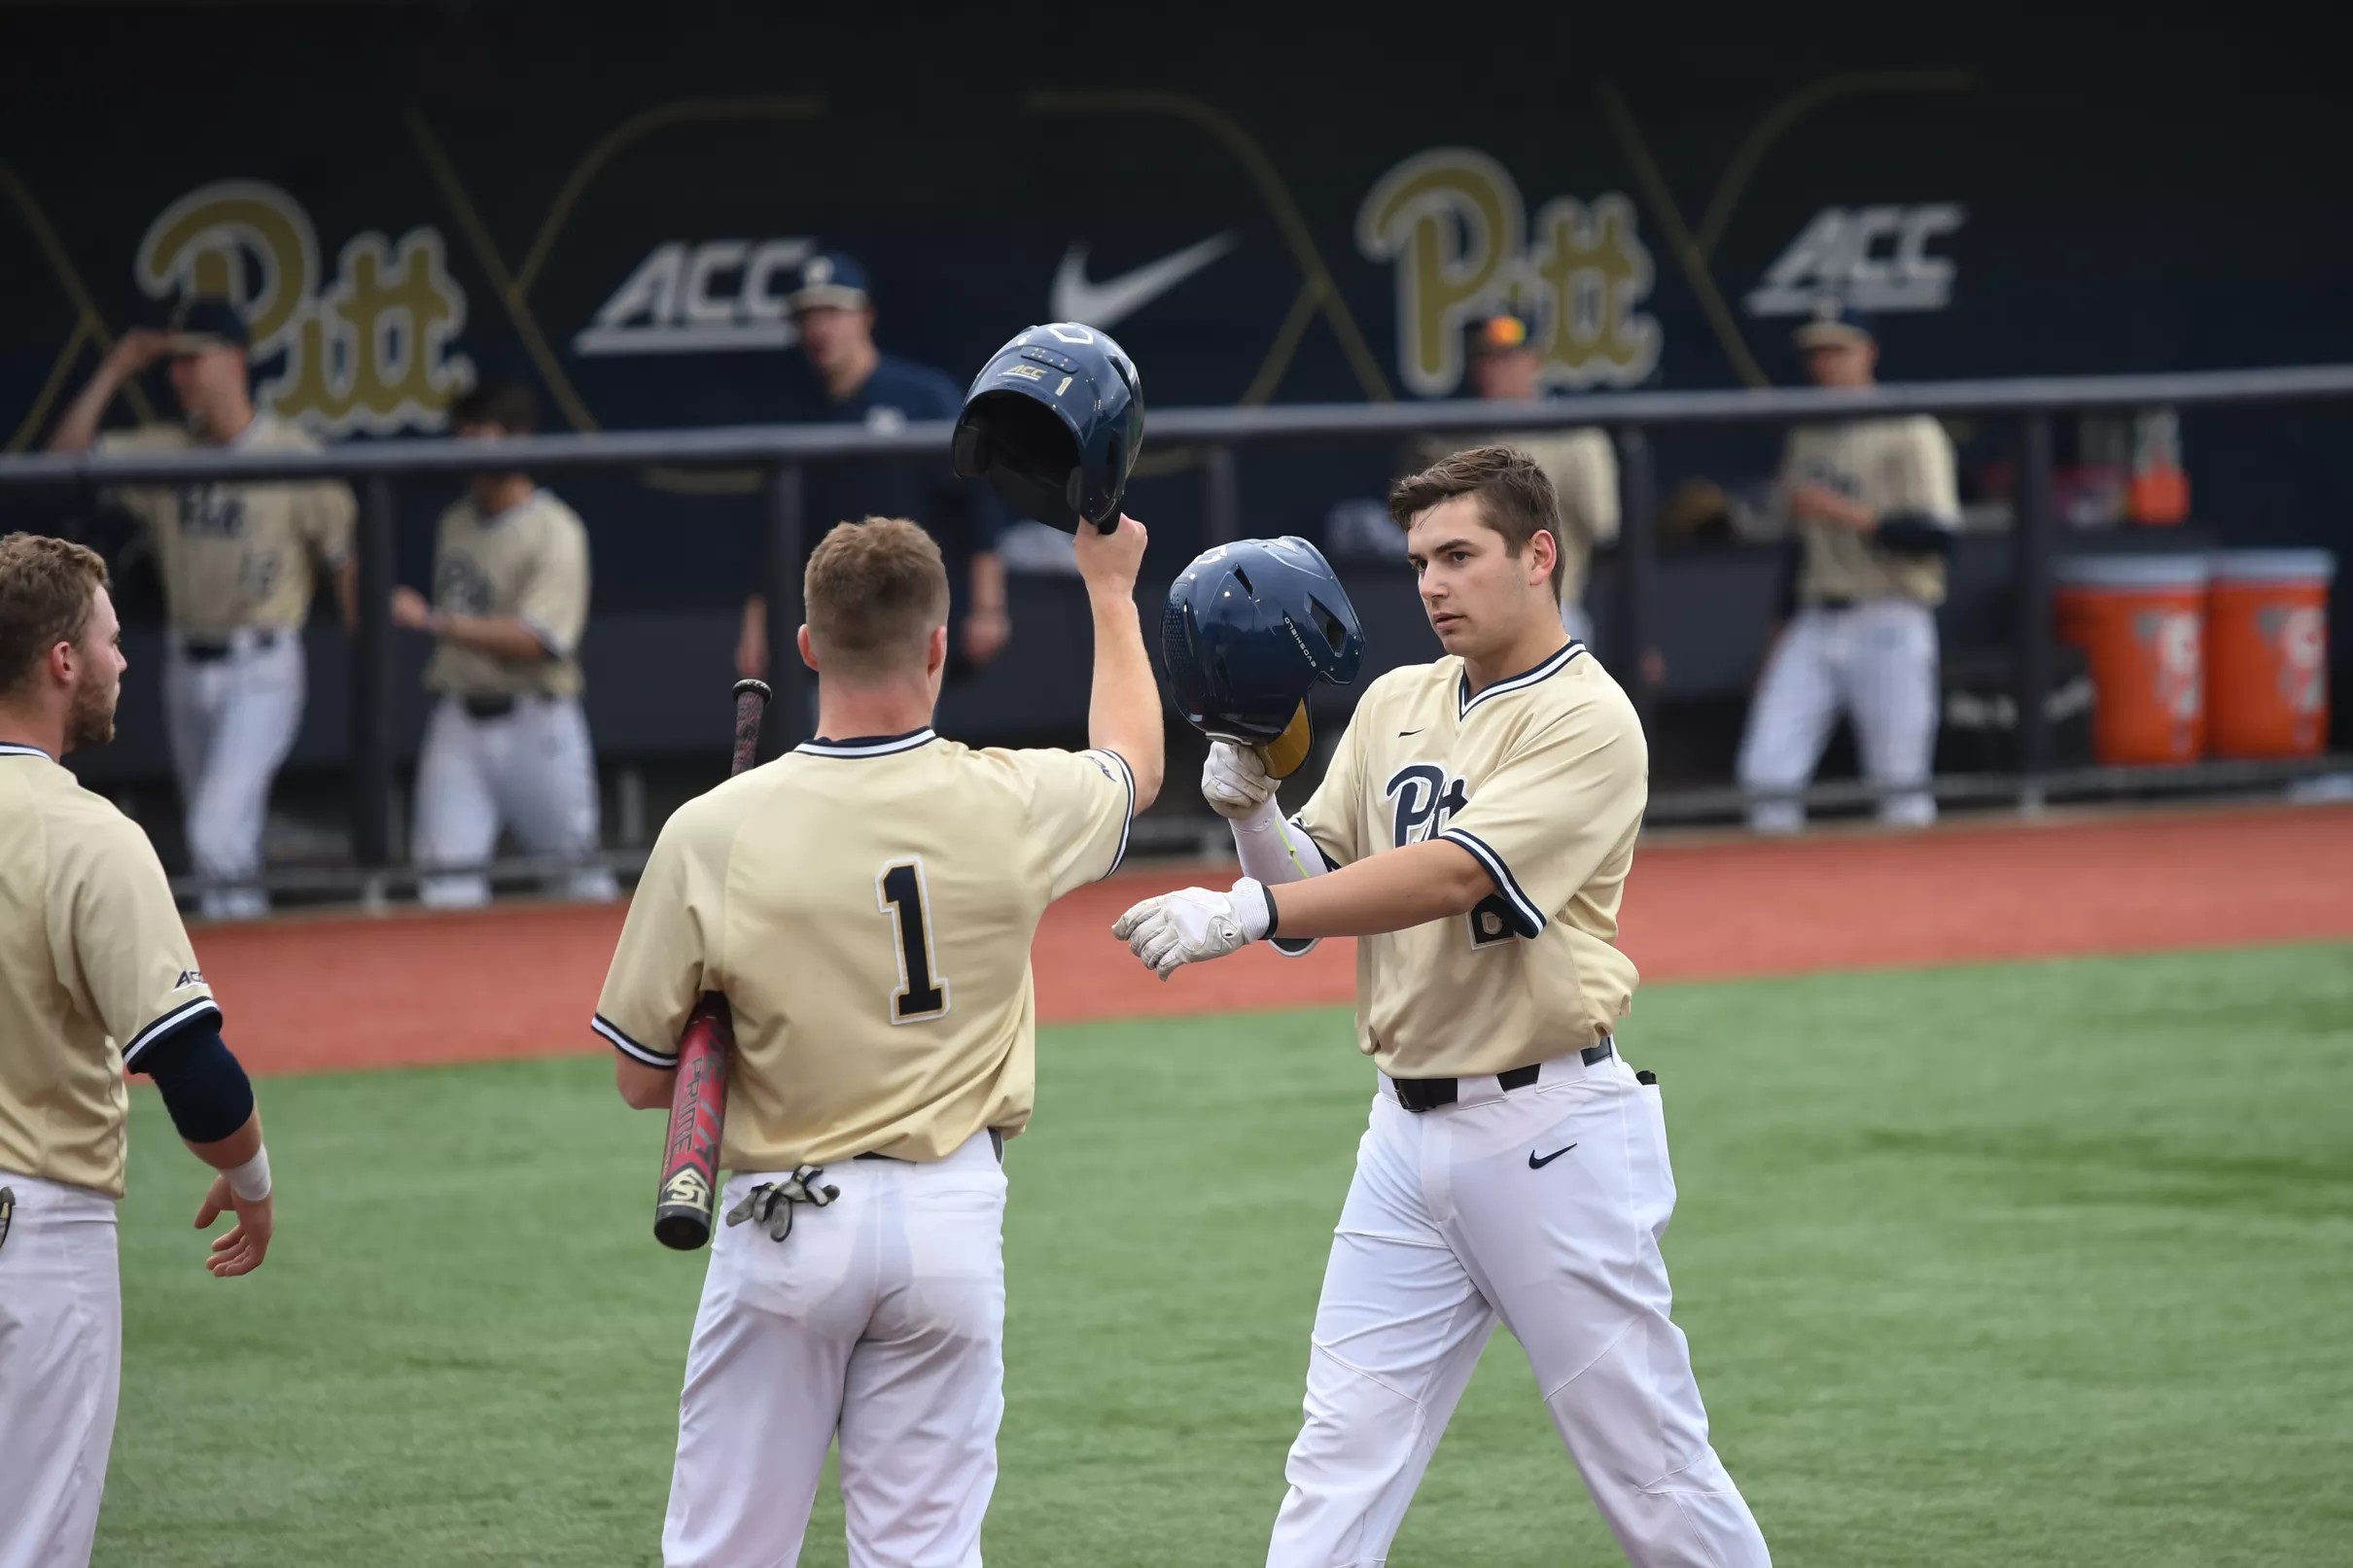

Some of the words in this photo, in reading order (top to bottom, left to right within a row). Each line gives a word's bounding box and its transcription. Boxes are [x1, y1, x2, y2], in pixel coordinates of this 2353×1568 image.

[593, 241, 813, 325] ACC
[1763, 204, 1967, 284] ACC
[135, 179, 475, 437] Pitt
[1009, 366, 1046, 378] ACC
[1284, 616, 1317, 668] EVOSHIELD
[175, 970, 206, 988] AC
[876, 855, 951, 1026] 1
